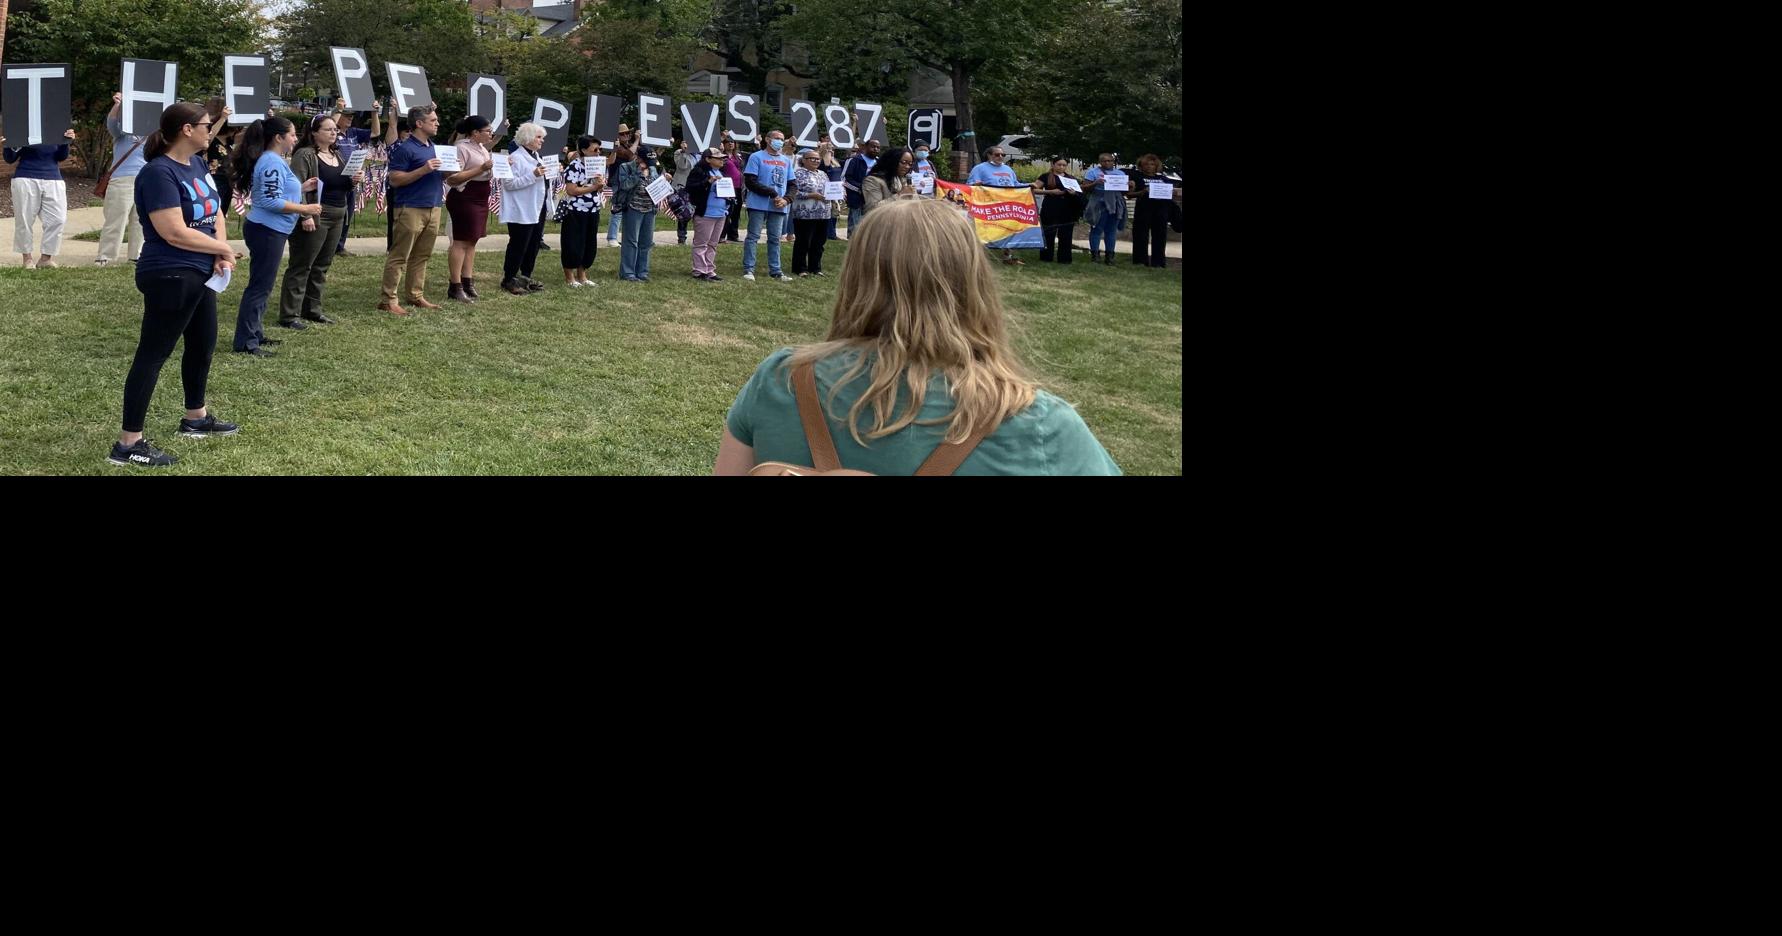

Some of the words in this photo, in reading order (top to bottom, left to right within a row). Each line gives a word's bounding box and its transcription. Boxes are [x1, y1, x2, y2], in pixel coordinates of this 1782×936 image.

[971, 205, 991, 215] MAKE
[992, 205, 1010, 213] THE
[1012, 205, 1035, 216] ROAD
[129, 454, 150, 463] HOKA
